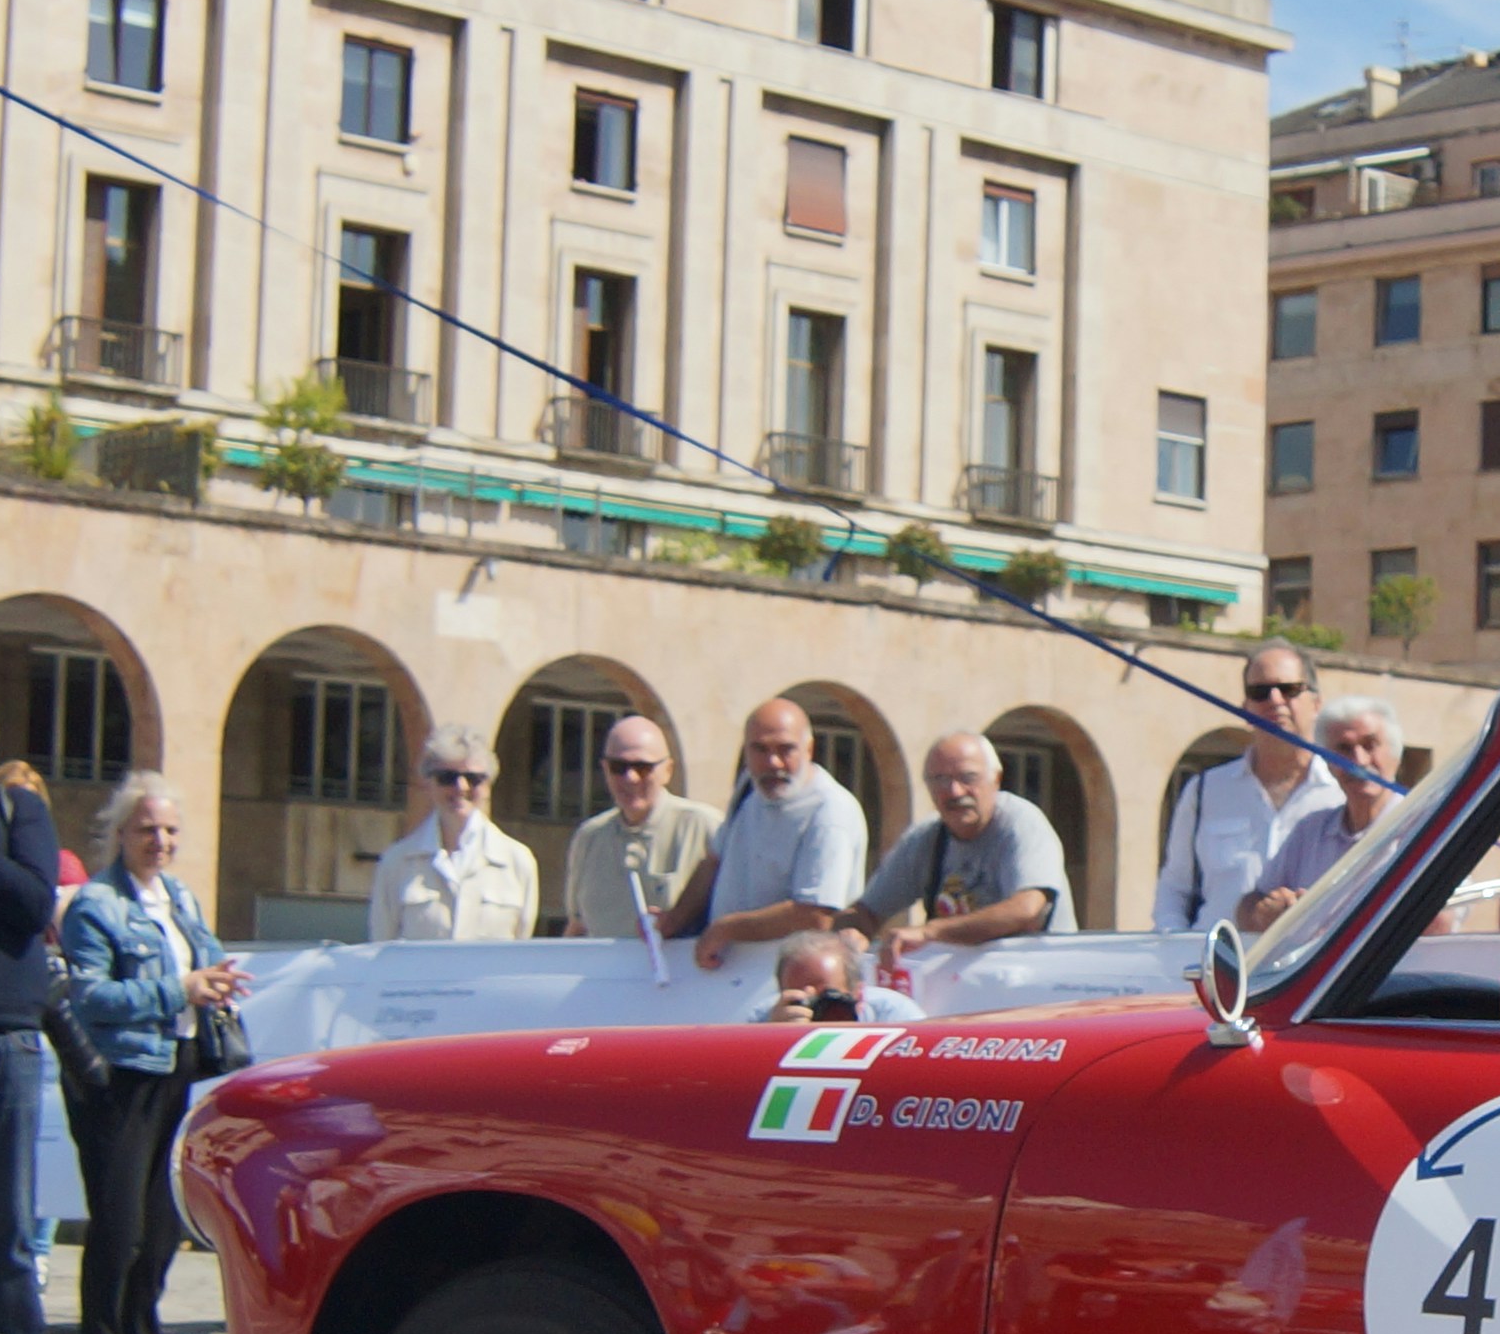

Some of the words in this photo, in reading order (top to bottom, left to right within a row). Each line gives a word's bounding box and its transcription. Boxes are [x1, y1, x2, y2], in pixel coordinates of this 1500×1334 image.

[884, 1036, 924, 1058] A.
[928, 1036, 1067, 1062] FARINA
[848, 1094, 884, 1128] D.
[891, 1096, 1025, 1132] CIRONI
